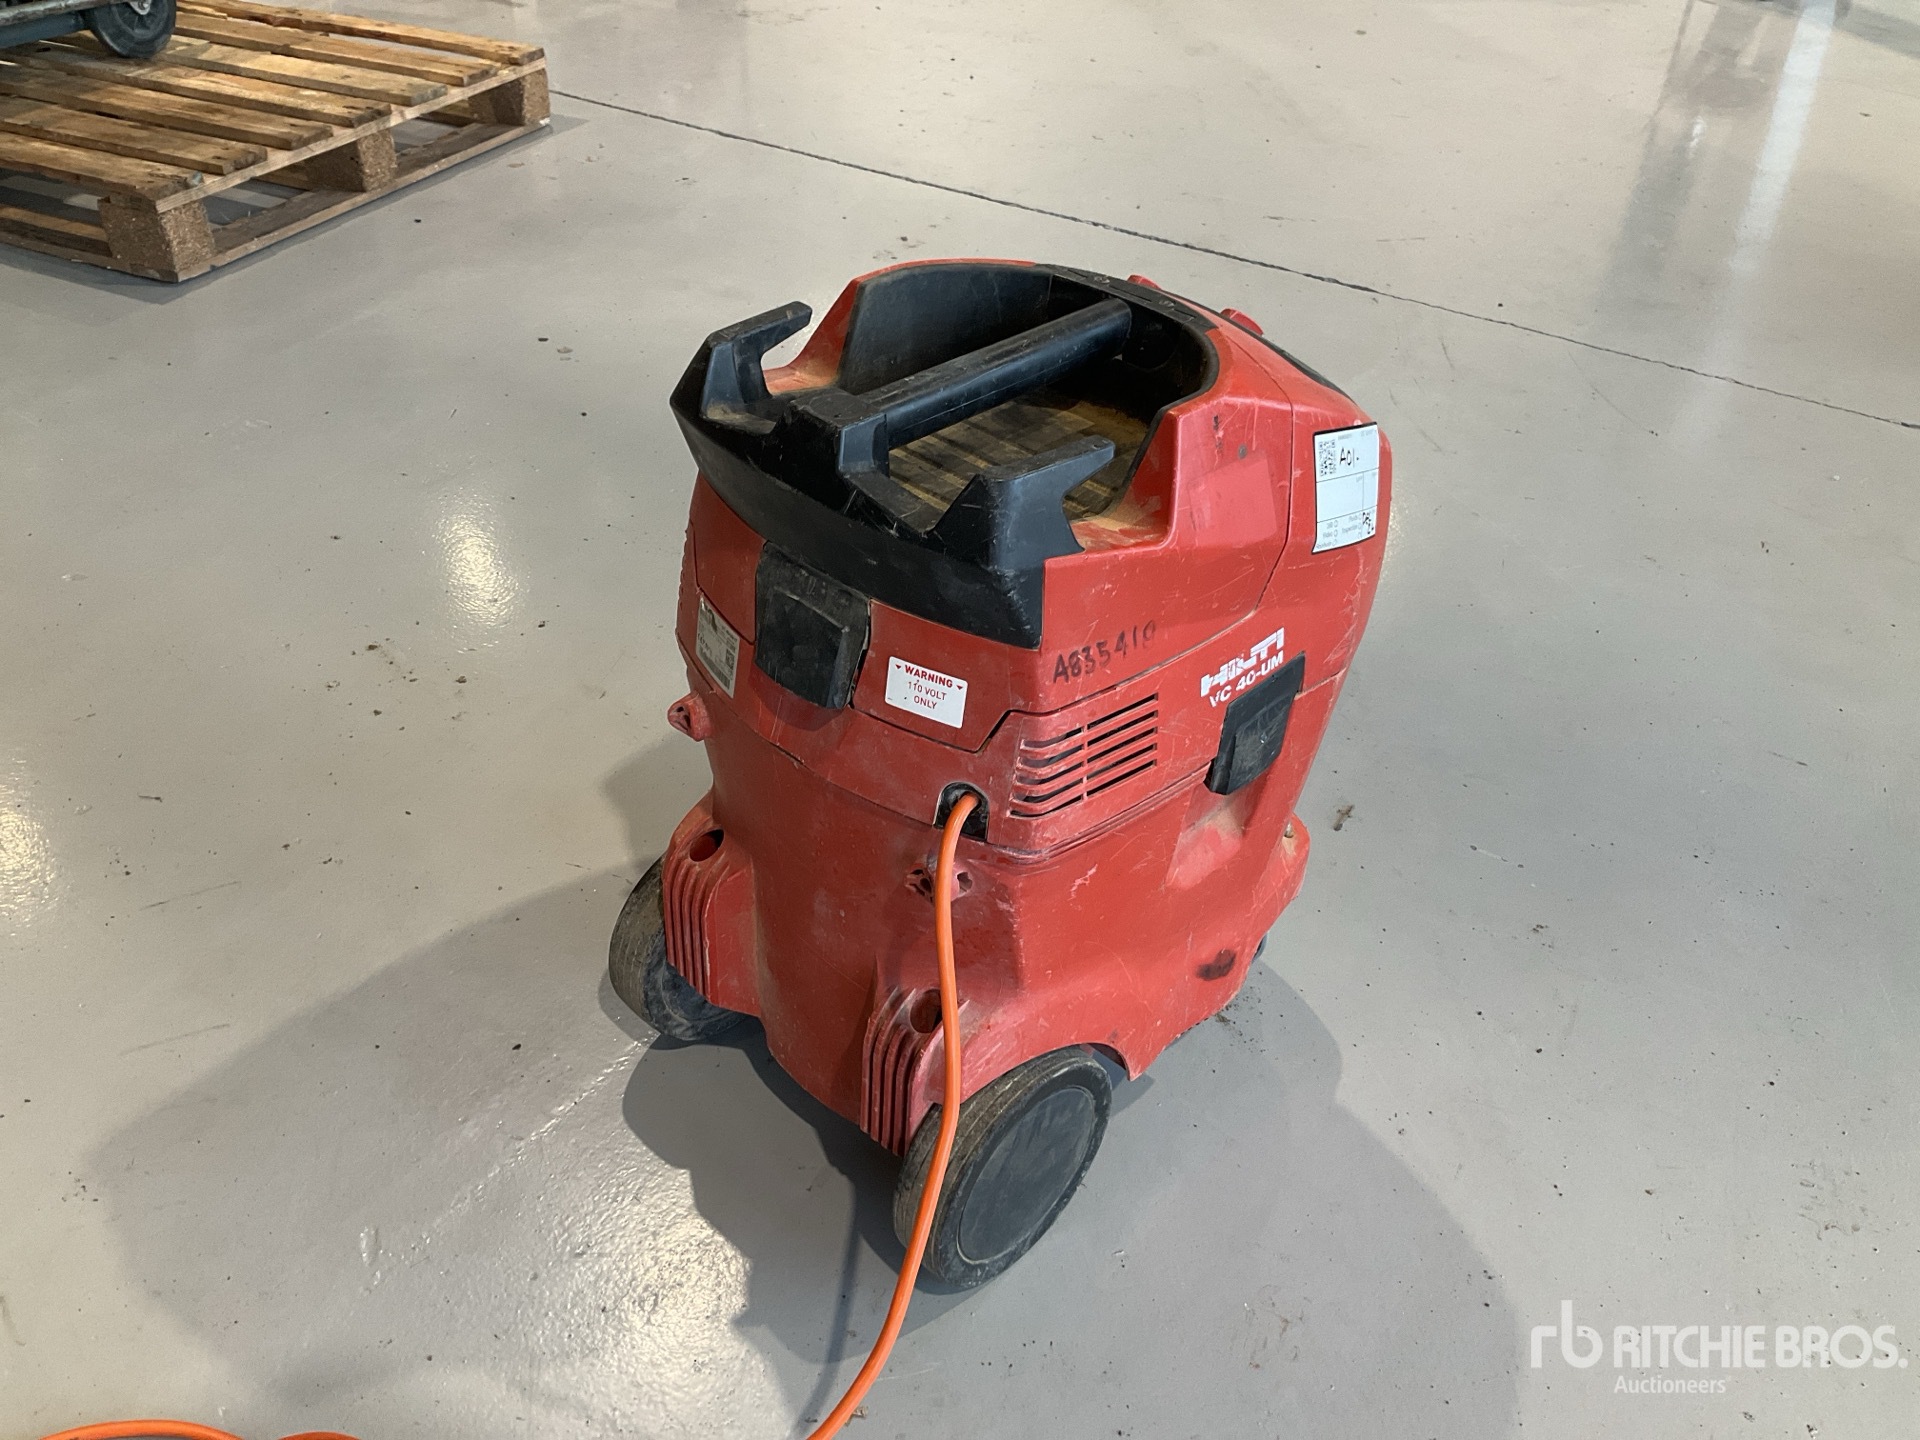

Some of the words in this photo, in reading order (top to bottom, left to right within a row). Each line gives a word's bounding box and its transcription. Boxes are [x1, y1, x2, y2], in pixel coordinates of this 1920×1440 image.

[1200, 627, 1285, 697] HILTI
[904, 664, 953, 688] WARNING
[1209, 687, 1232, 707] VC
[1235, 650, 1284, 693] 40-UM
[908, 681, 923, 693] 110
[924, 687, 947, 701] VOLT
[913, 695, 938, 710] ONLY
